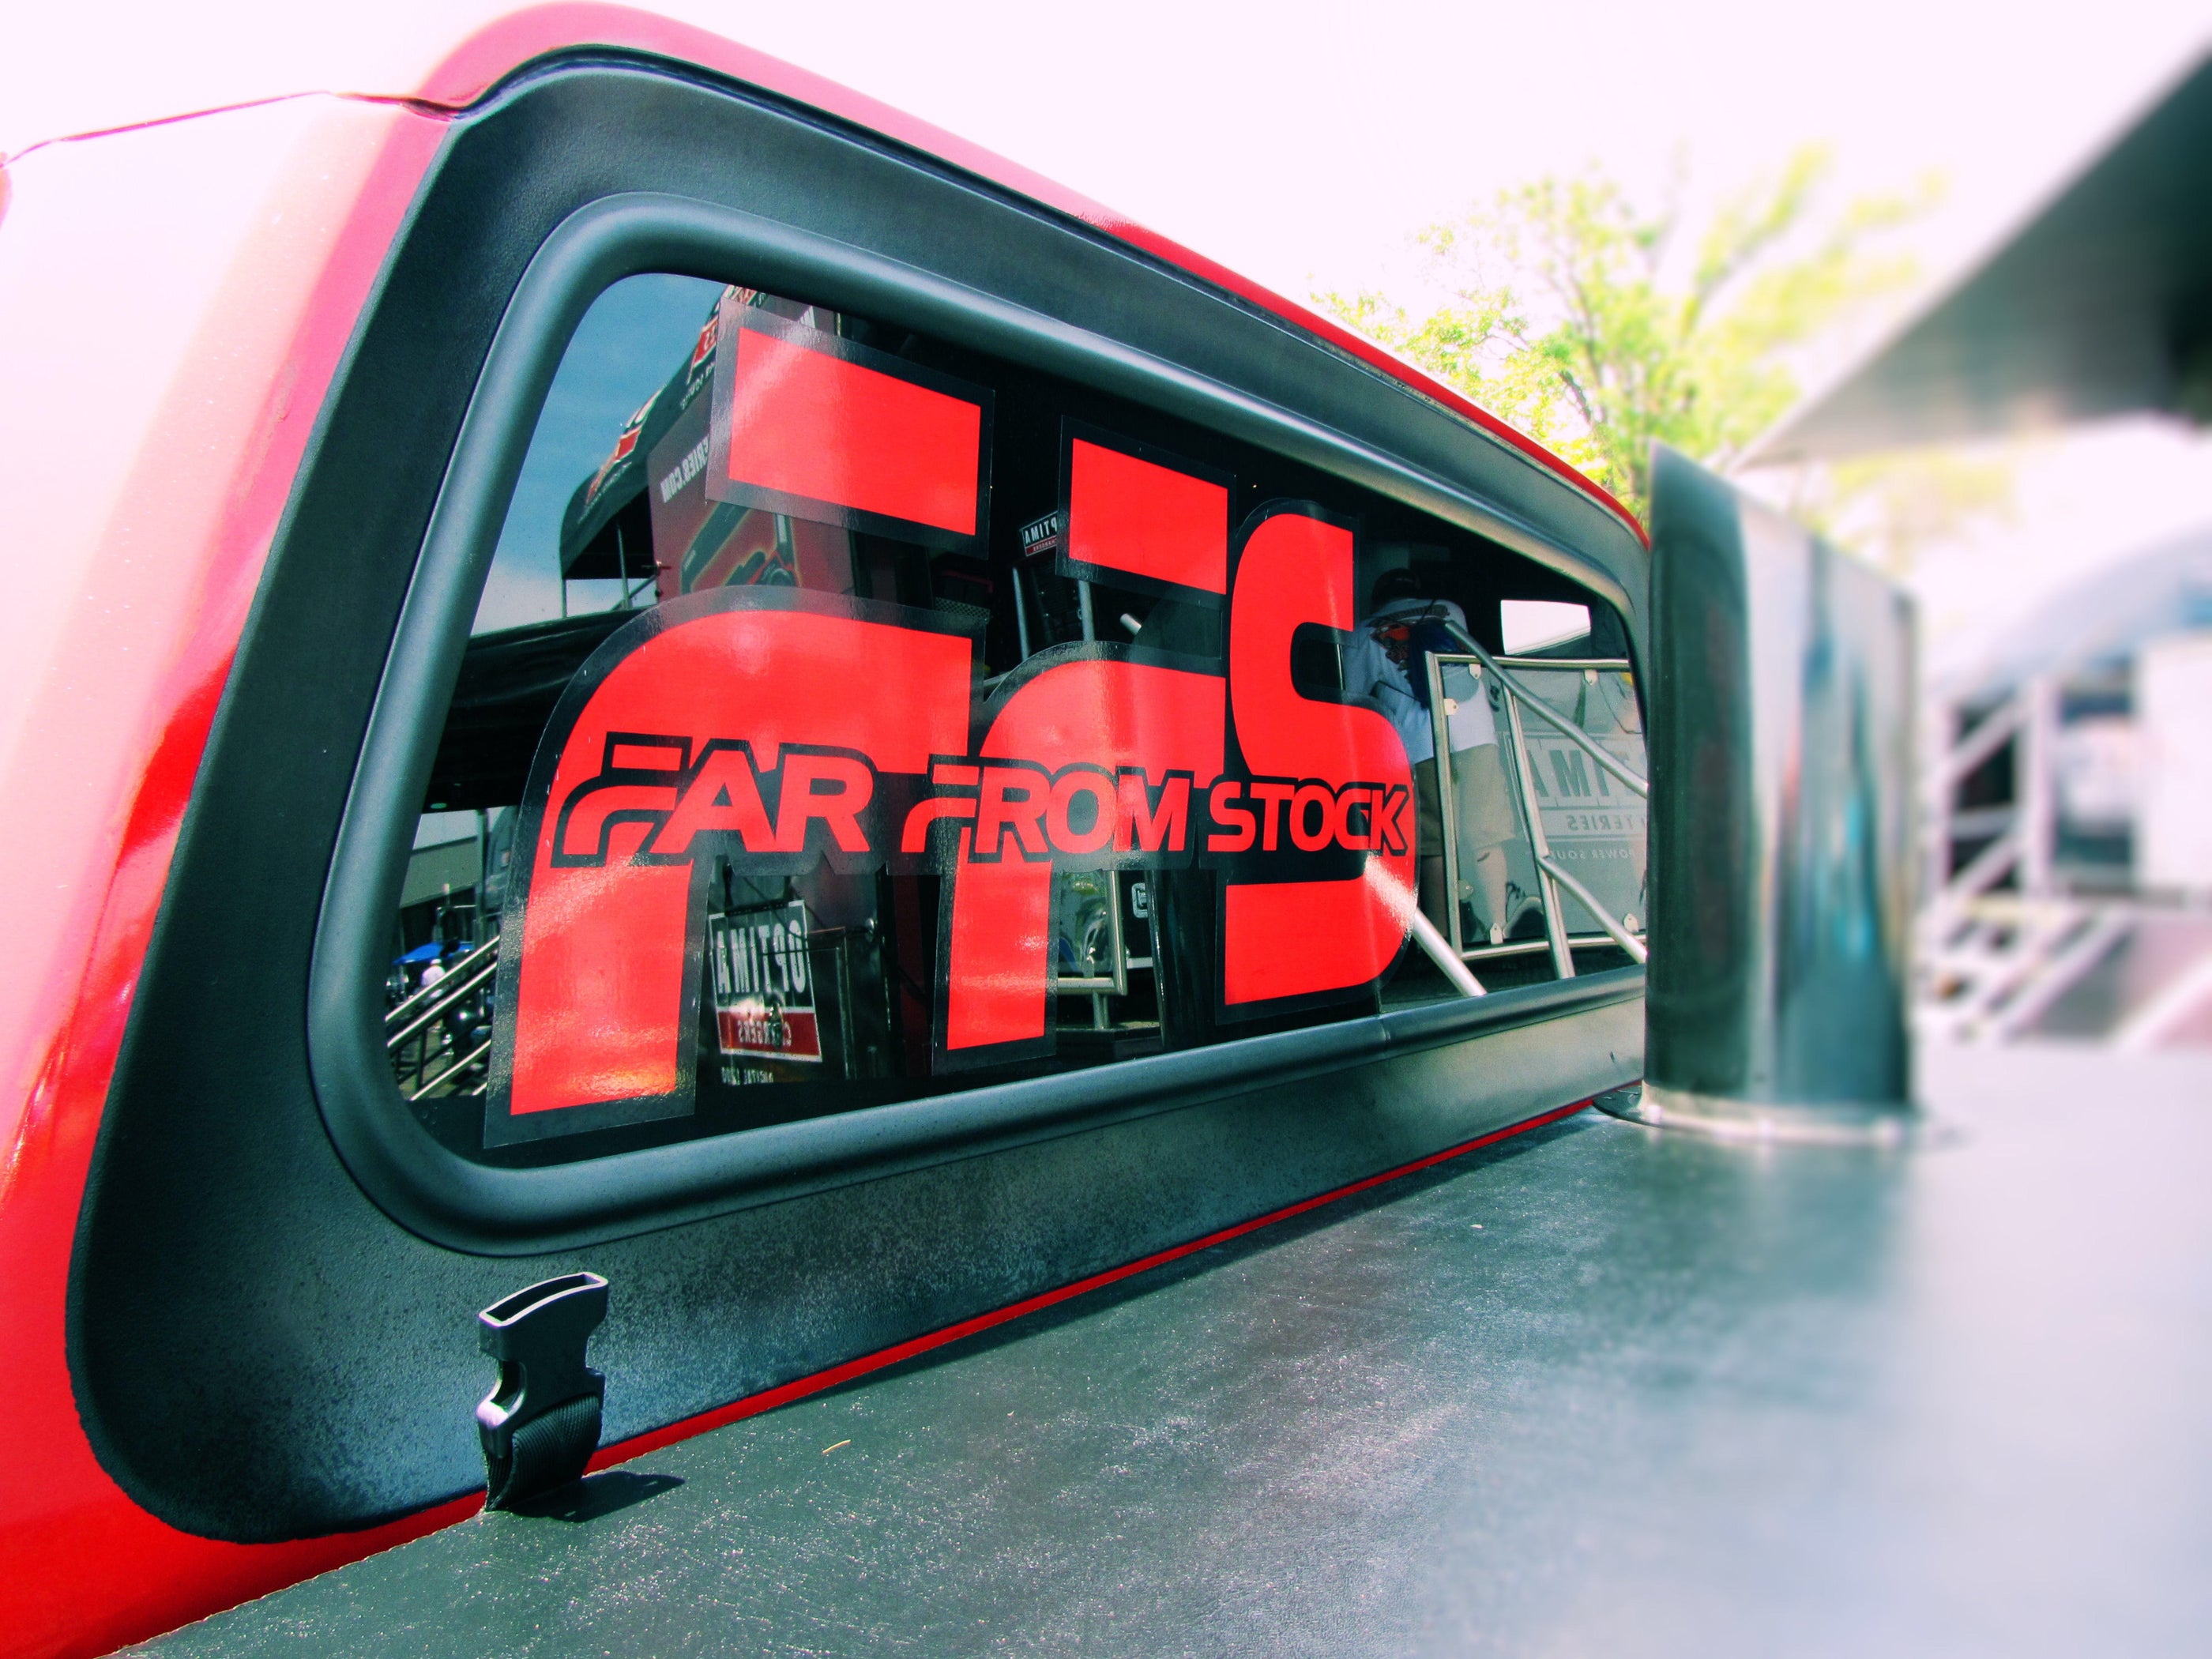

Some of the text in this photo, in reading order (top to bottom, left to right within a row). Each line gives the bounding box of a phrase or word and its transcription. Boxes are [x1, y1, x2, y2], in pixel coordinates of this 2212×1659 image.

[562, 743, 1410, 854] FAR FROM STOCK
